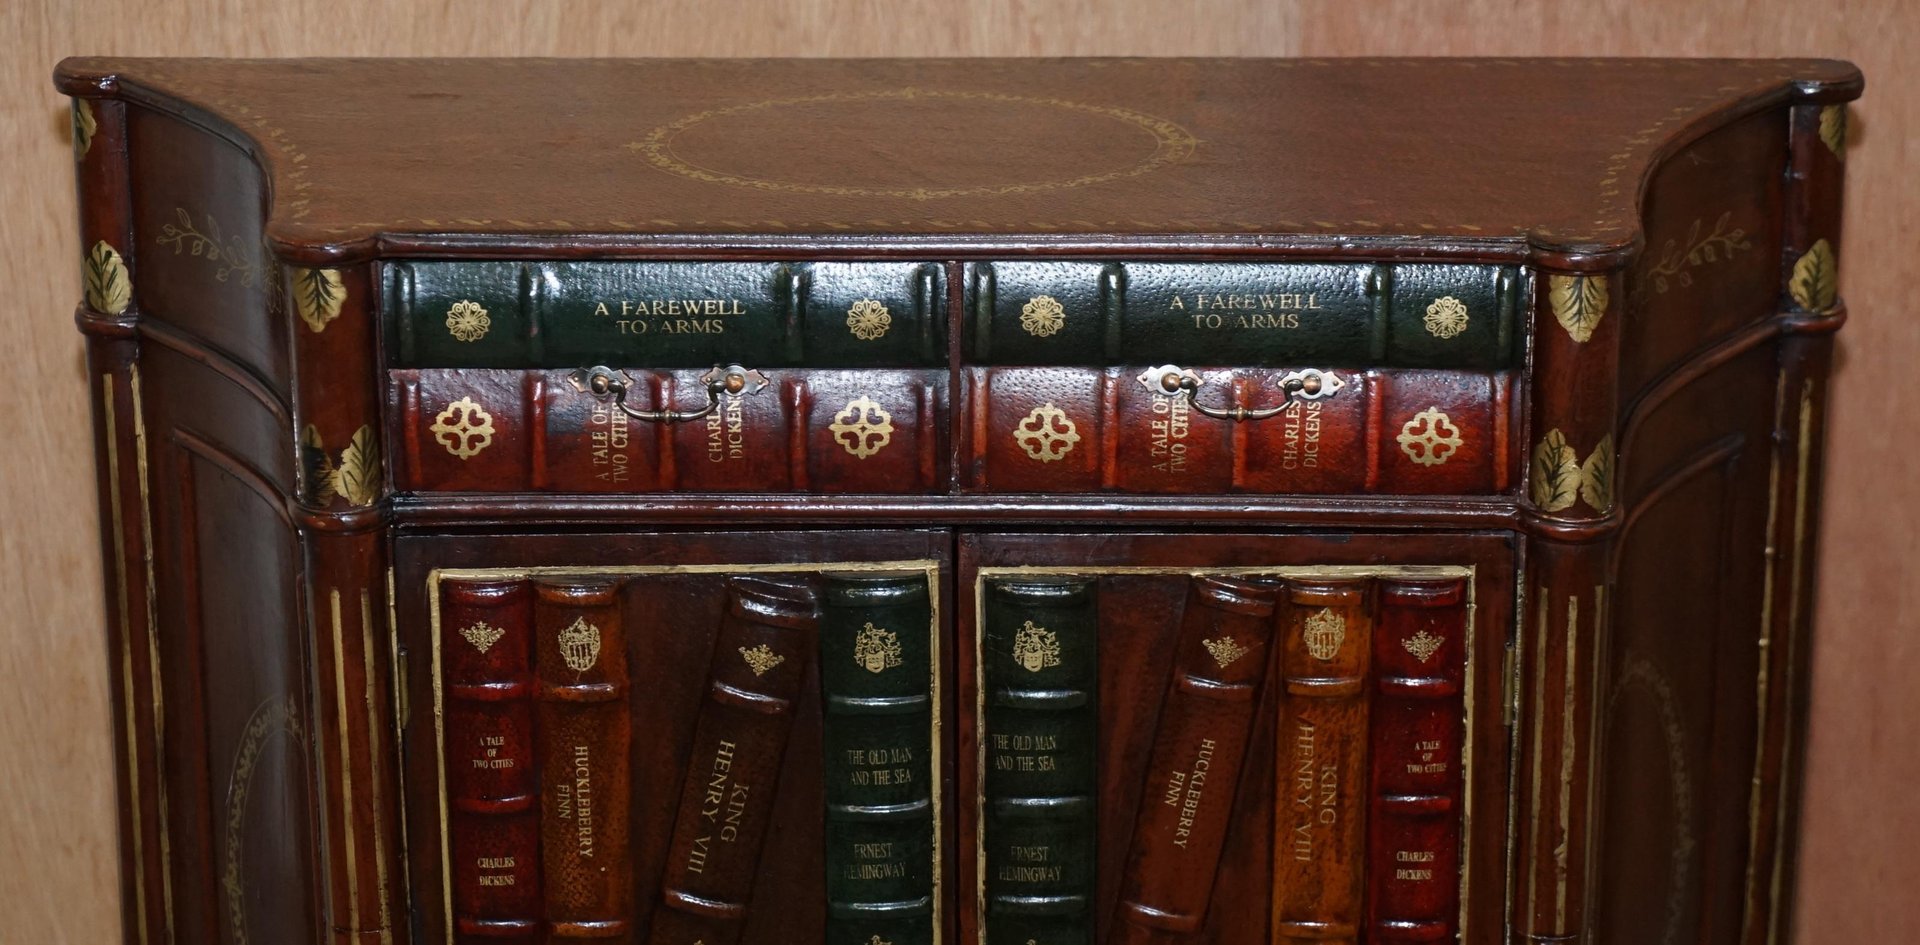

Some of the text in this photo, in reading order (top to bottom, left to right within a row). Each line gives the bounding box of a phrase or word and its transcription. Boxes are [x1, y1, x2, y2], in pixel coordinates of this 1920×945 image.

[594, 300, 747, 316] A FAREWELL
[1169, 293, 1323, 310] A FAREWELL
[616, 319, 724, 335] TO ARMS
[1191, 313, 1299, 329] TO ARMS
[706, 392, 723, 463] CHARL
[1152, 393, 1169, 472] A TALE OF
[1283, 400, 1301, 470] CHARLES
[1303, 401, 1321, 468] DICKENS
[591, 401, 610, 481] A TALE OF
[1171, 443, 1187, 473] TWO
[612, 454, 629, 483] TWO
[486, 736, 505, 746] TALE
[992, 733, 1057, 751] THE OLD MAN
[1414, 740, 1441, 751] A TALE
[487, 748, 497, 757] OF
[847, 747, 912, 765] THE OLD MAN
[1422, 752, 1433, 762] OF
[472, 758, 515, 769] TWO CITIES
[995, 755, 1056, 771] AND THE SEA
[1406, 764, 1423, 774] TWO
[850, 768, 912, 785] AND THE SEA
[1164, 770, 1186, 808] FINN
[1173, 738, 1216, 849] HUCKLEBERRY
[1295, 726, 1314, 862] HENRY VIII
[1320, 766, 1337, 825] KING
[557, 784, 571, 819] FINN
[574, 746, 593, 857] HUCKLEBERRY
[687, 739, 736, 874] HENRY VIII
[720, 782, 750, 843] KING
[853, 842, 893, 859] ERNEST
[1010, 846, 1049, 862] ERNEST
[1396, 851, 1435, 862] CHARLES
[477, 857, 515, 869] CHARLES
[479, 874, 515, 886] DICKENS
[999, 865, 1062, 882] HEMINGWAY
[1396, 869, 1432, 880] DICKENS
